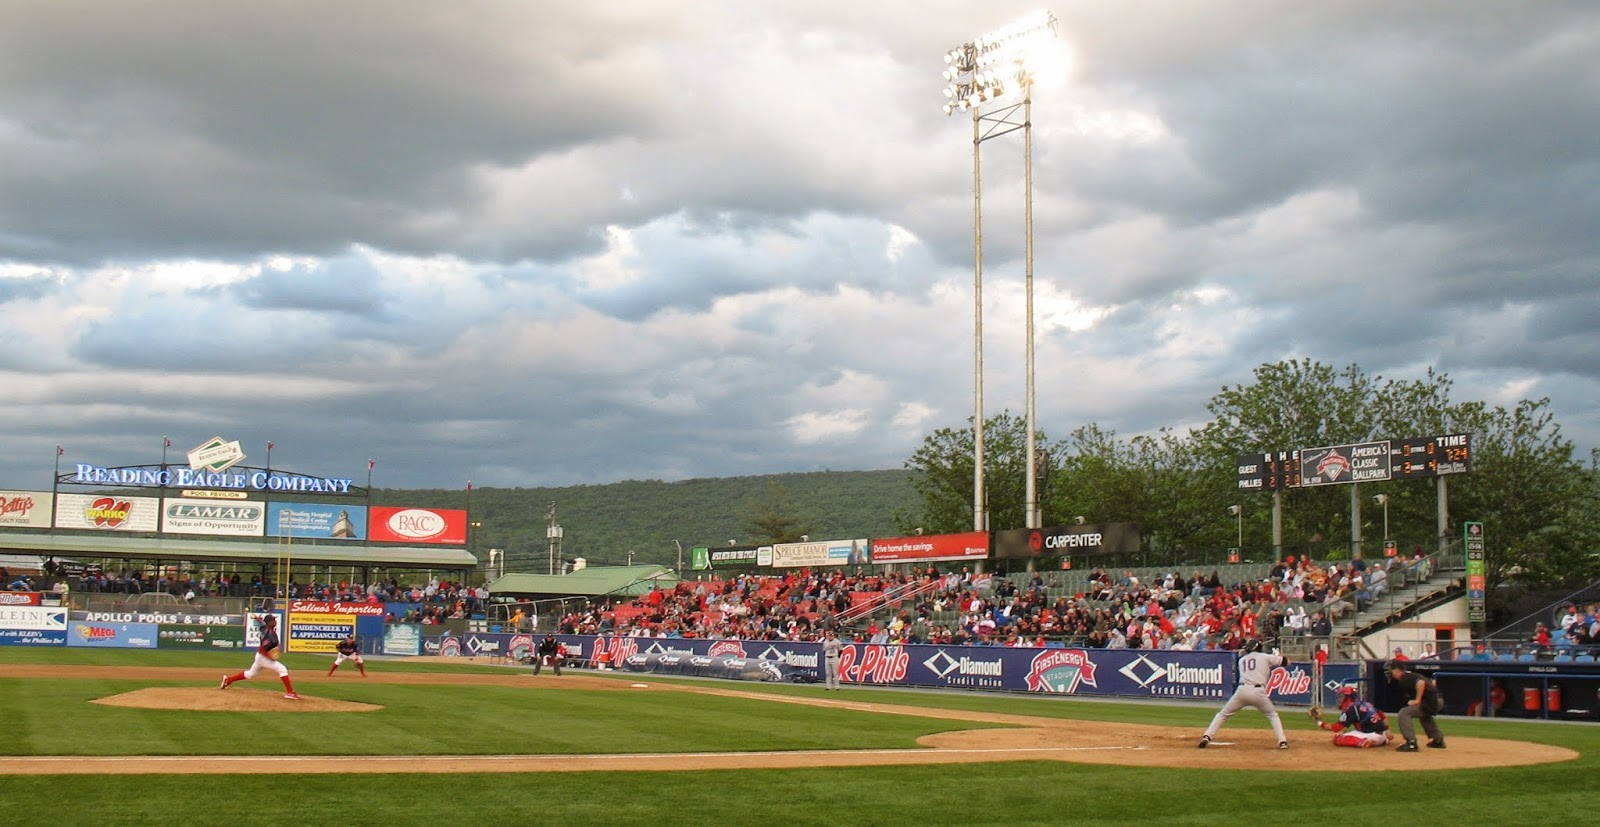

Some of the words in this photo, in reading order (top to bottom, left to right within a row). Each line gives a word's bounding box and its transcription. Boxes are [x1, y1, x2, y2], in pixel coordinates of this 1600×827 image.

[1436, 435, 1467, 447] TIME
[1264, 453, 1272, 463] R
[1279, 451, 1287, 461] H
[1291, 450, 1299, 460] E
[1351, 444, 1388, 457] AMERICA'S
[1238, 465, 1258, 474] GUEST
[1351, 458, 1379, 469] CLASSIC
[77, 463, 170, 486] READING
[176, 467, 246, 489] EAGLE
[251, 471, 352, 493] COMPANY
[1352, 469, 1387, 480] BALLPARK
[1238, 478, 1263, 488] PHILLIES
[87, 509, 127, 519] WARKO
[175, 506, 252, 519] LAMAR
[204, 521, 259, 529] Opportunity
[398, 515, 435, 535] RACC
[1045, 533, 1102, 549] CARPENTER
[775, 545, 801, 560] SPRUCE
[803, 545, 828, 556] MANOR
[874, 545, 887, 553] Drive
[887, 544, 903, 552] home
[903, 543, 912, 551] the
[291, 602, 330, 612] Salino's
[333, 602, 383, 615] Importing
[86, 613, 132, 622] APOLLO
[138, 614, 177, 623] POOLS
[184, 615, 192, 623] &
[199, 615, 228, 625] SPAS
[90, 627, 116, 637] MEGA
[785, 650, 818, 667] Diamond
[839, 645, 910, 683] R-Phils
[1035, 650, 1084, 674] FIRSTENERGY
[960, 656, 1002, 677] Diamond
[1242, 658, 1256, 673] 10
[1046, 670, 1074, 681] STADIUM
[1167, 662, 1222, 685] Diamond
[947, 675, 974, 685] Credit
[979, 677, 1002, 687] Union
[1151, 685, 1186, 696] Credit
[1193, 687, 1223, 697] Union
